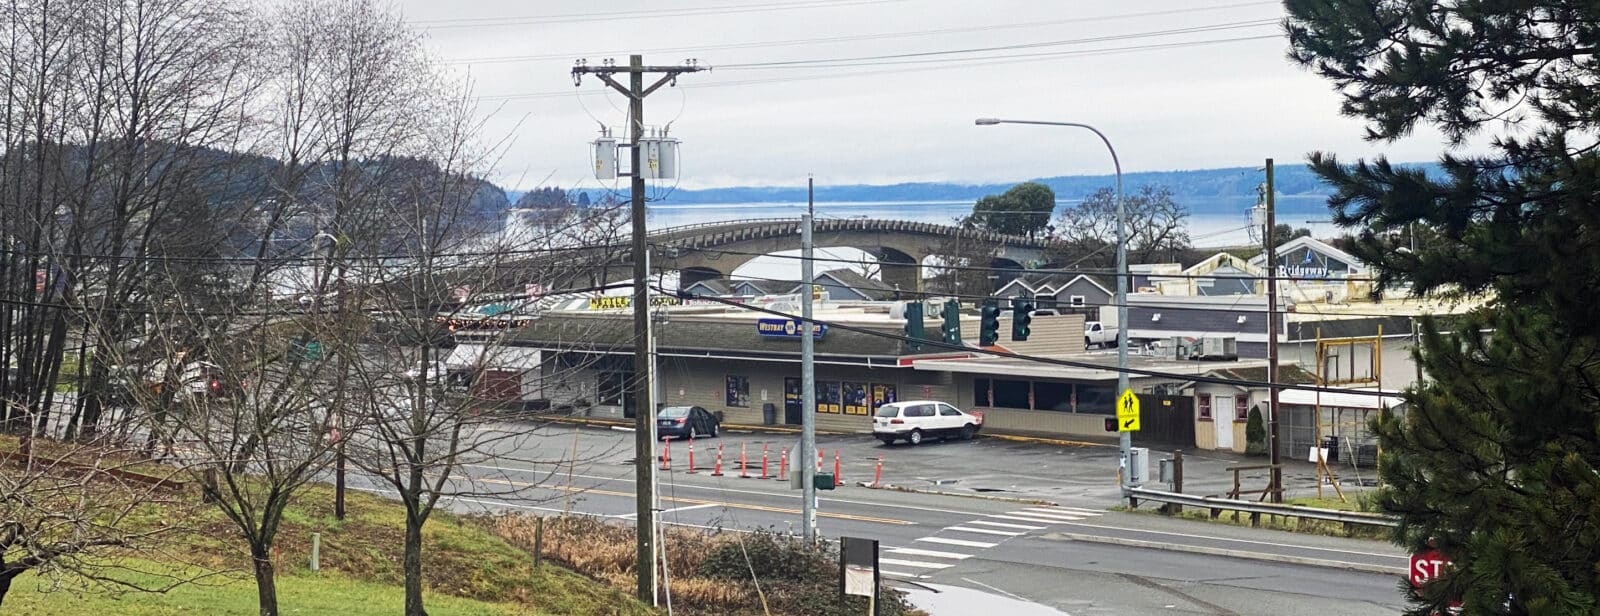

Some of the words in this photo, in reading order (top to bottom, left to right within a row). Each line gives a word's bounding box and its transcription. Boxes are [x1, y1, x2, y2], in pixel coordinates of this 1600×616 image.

[1278, 264, 1327, 278] Bridgeway
[759, 322, 784, 331] WESTBAY
[1414, 559, 1452, 583] ST
